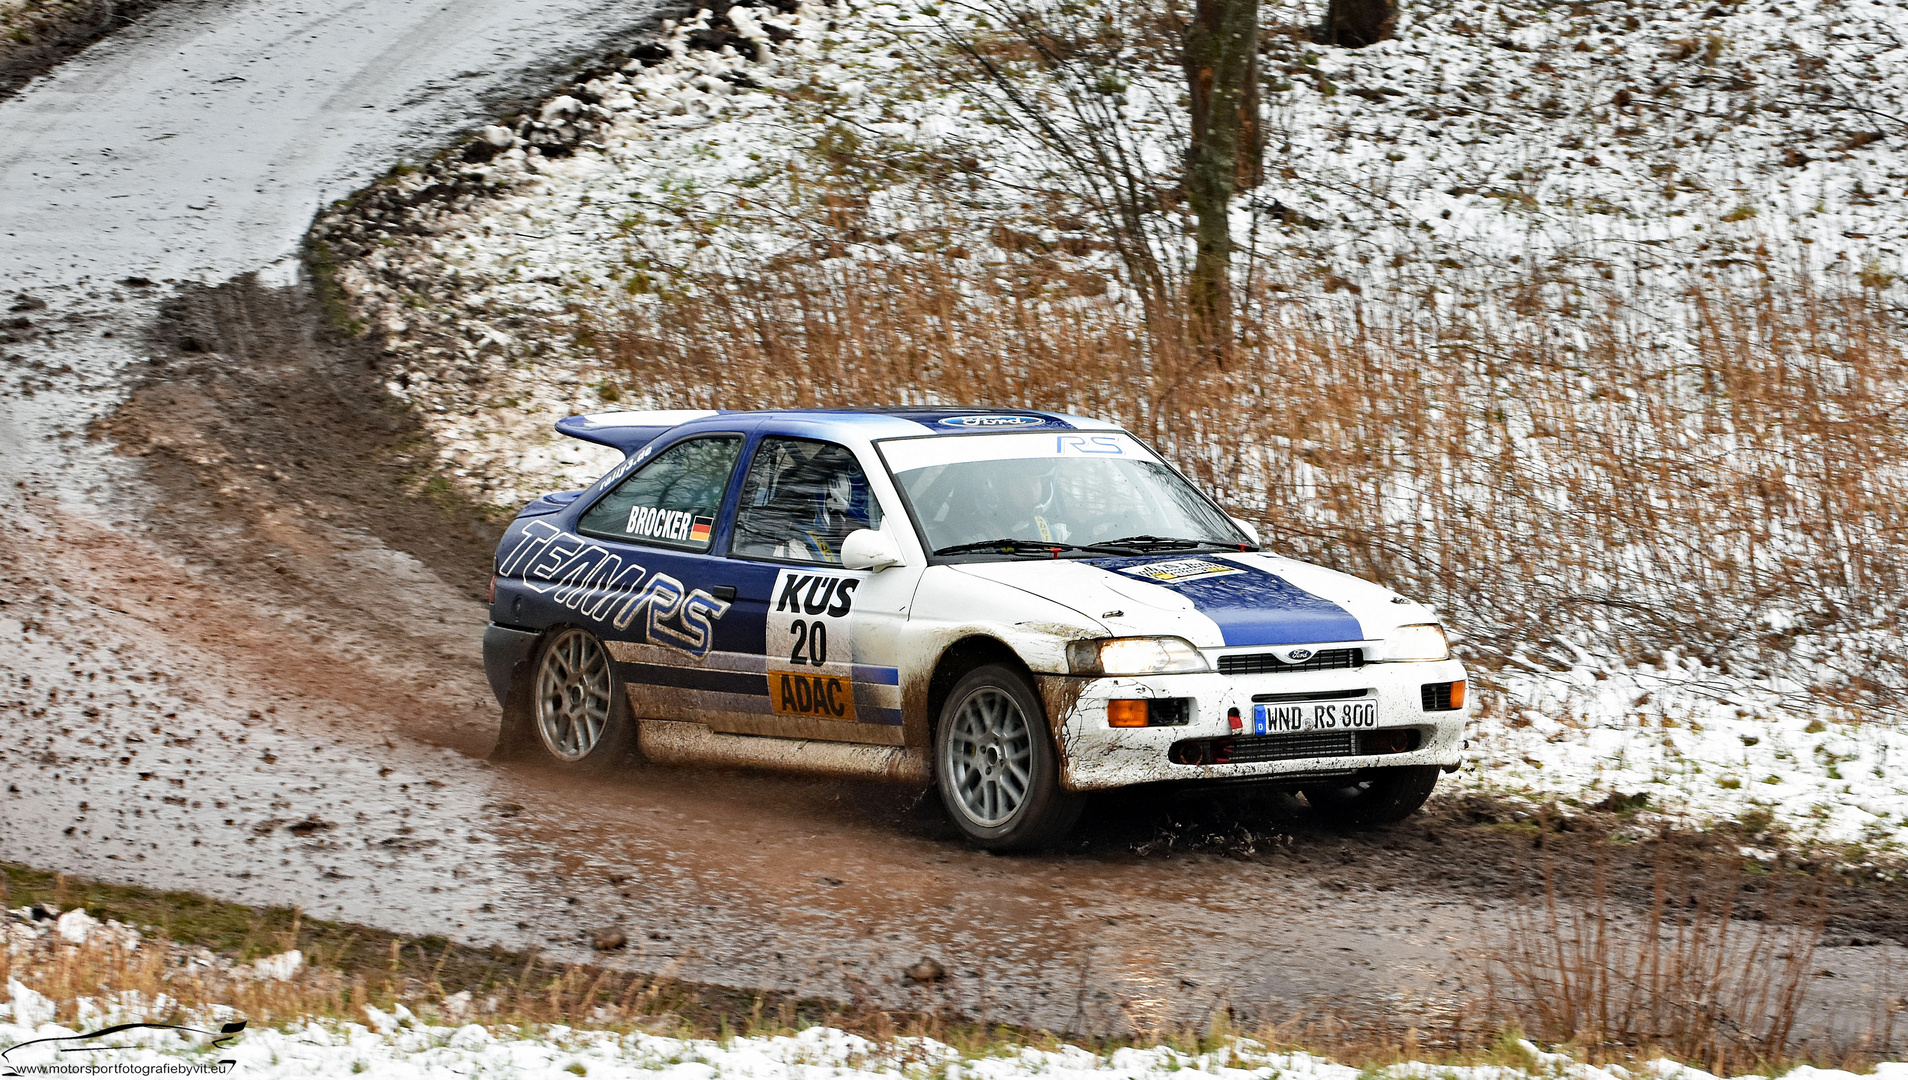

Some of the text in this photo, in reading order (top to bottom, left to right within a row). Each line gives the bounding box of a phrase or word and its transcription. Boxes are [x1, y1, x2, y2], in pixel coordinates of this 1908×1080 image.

[961, 415, 1027, 427] Ford
[1056, 435, 1124, 455] RS
[626, 505, 692, 541] BROCKER
[498, 520, 731, 660] TEAM RS
[776, 574, 860, 618] KÜS
[790, 619, 827, 667] 20
[1290, 649, 1309, 660] Ford
[780, 674, 845, 717] ADAC
[1258, 723, 1263, 731] D
[1267, 706, 1302, 731] WND
[1314, 705, 1336, 729] RS
